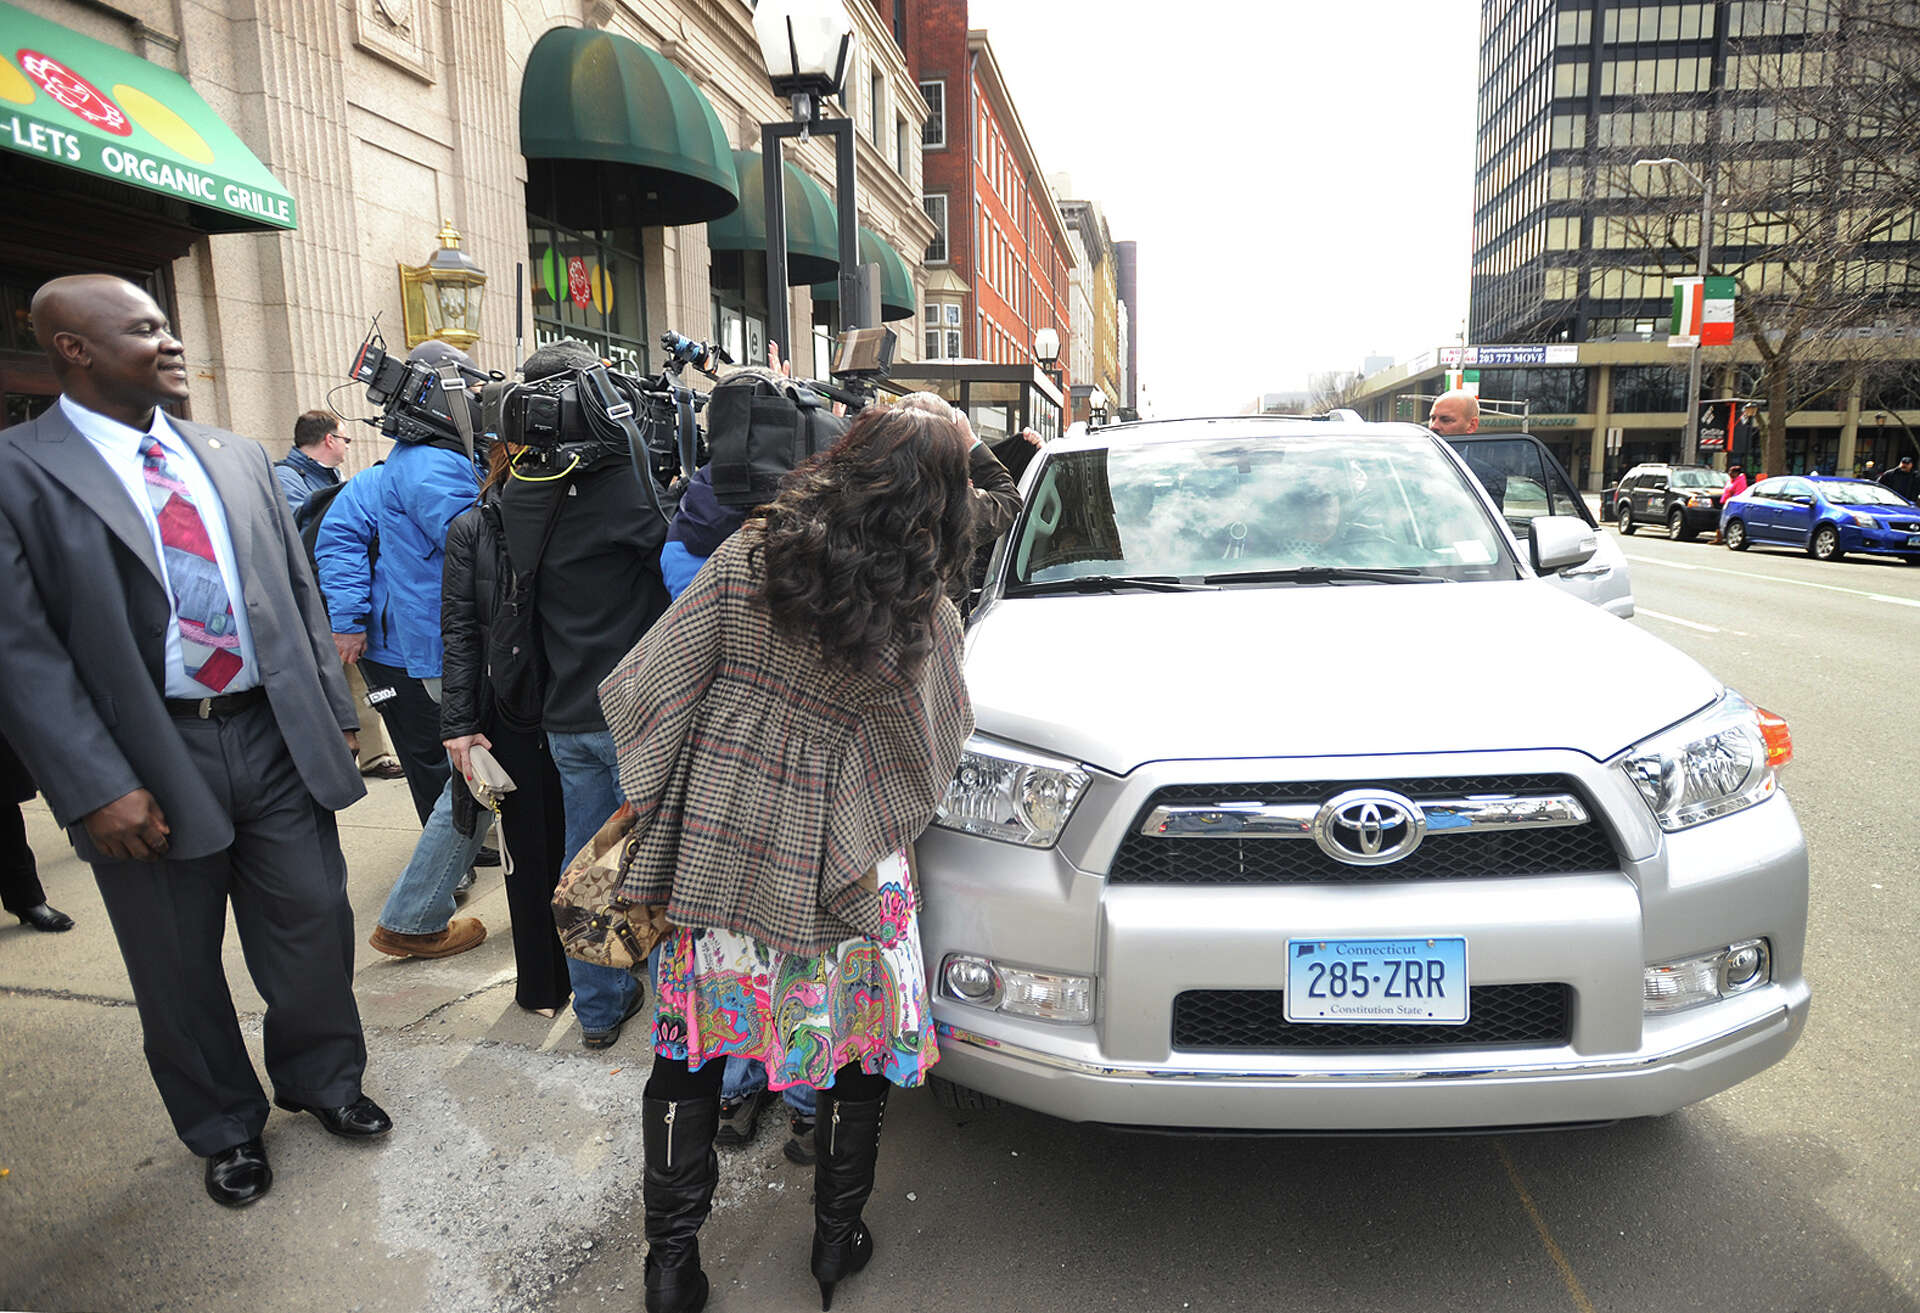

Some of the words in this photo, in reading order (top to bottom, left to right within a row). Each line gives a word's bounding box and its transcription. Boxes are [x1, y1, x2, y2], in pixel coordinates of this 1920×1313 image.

[102, 147, 217, 201] ORGANIC
[223, 184, 291, 223] GRILLE
[1513, 352, 1545, 363] MOVE
[1336, 943, 1417, 956] Connecticut
[1330, 1004, 1394, 1016] Constitution
[1396, 1004, 1423, 1016] State
